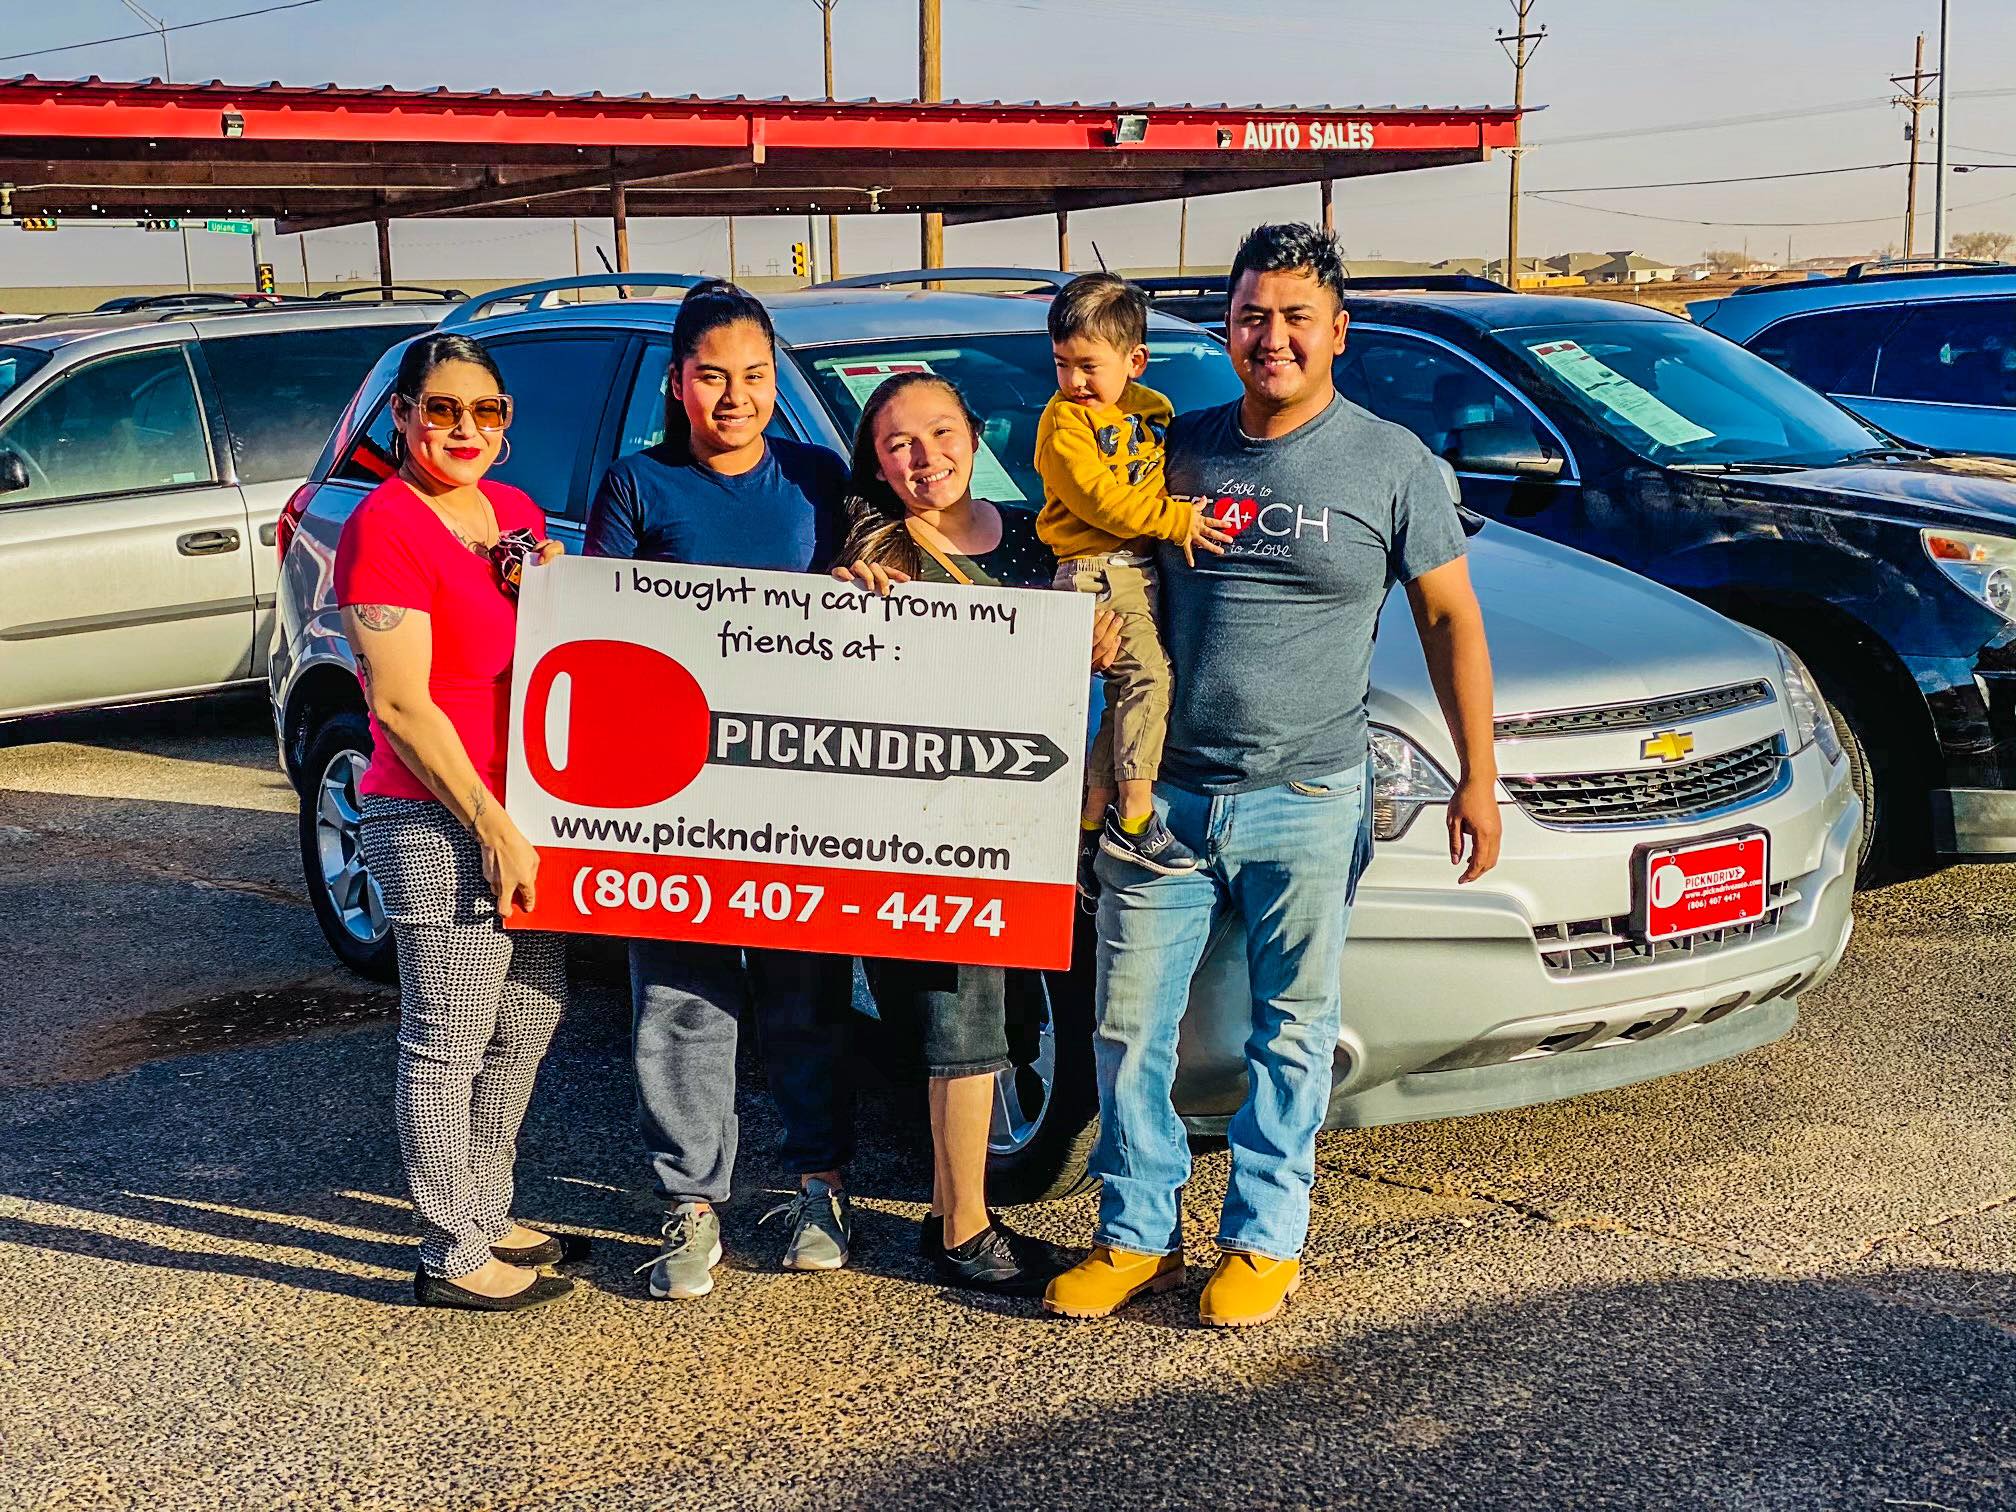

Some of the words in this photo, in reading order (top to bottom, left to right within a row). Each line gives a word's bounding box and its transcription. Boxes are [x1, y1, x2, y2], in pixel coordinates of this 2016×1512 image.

[1244, 121, 1300, 150] AUTO
[1309, 121, 1375, 150] SALES
[211, 222, 236, 233] Upland
[1216, 478, 1256, 496] Love
[1259, 485, 1273, 497] to
[1247, 538, 1293, 558] Love
[615, 571, 620, 593] I
[632, 567, 756, 611] bought
[763, 588, 811, 621] my
[821, 591, 875, 614] car
[880, 584, 958, 622] from
[969, 602, 1017, 635] my
[717, 620, 834, 661] friends
[842, 633, 885, 662] at
[716, 717, 1051, 777] PICKNDRIVE
[551, 815, 1011, 871] www.pickndriveauto.com
[572, 866, 713, 924] (806)
[727, 880, 826, 922] 407
[876, 890, 1006, 938] 4474
